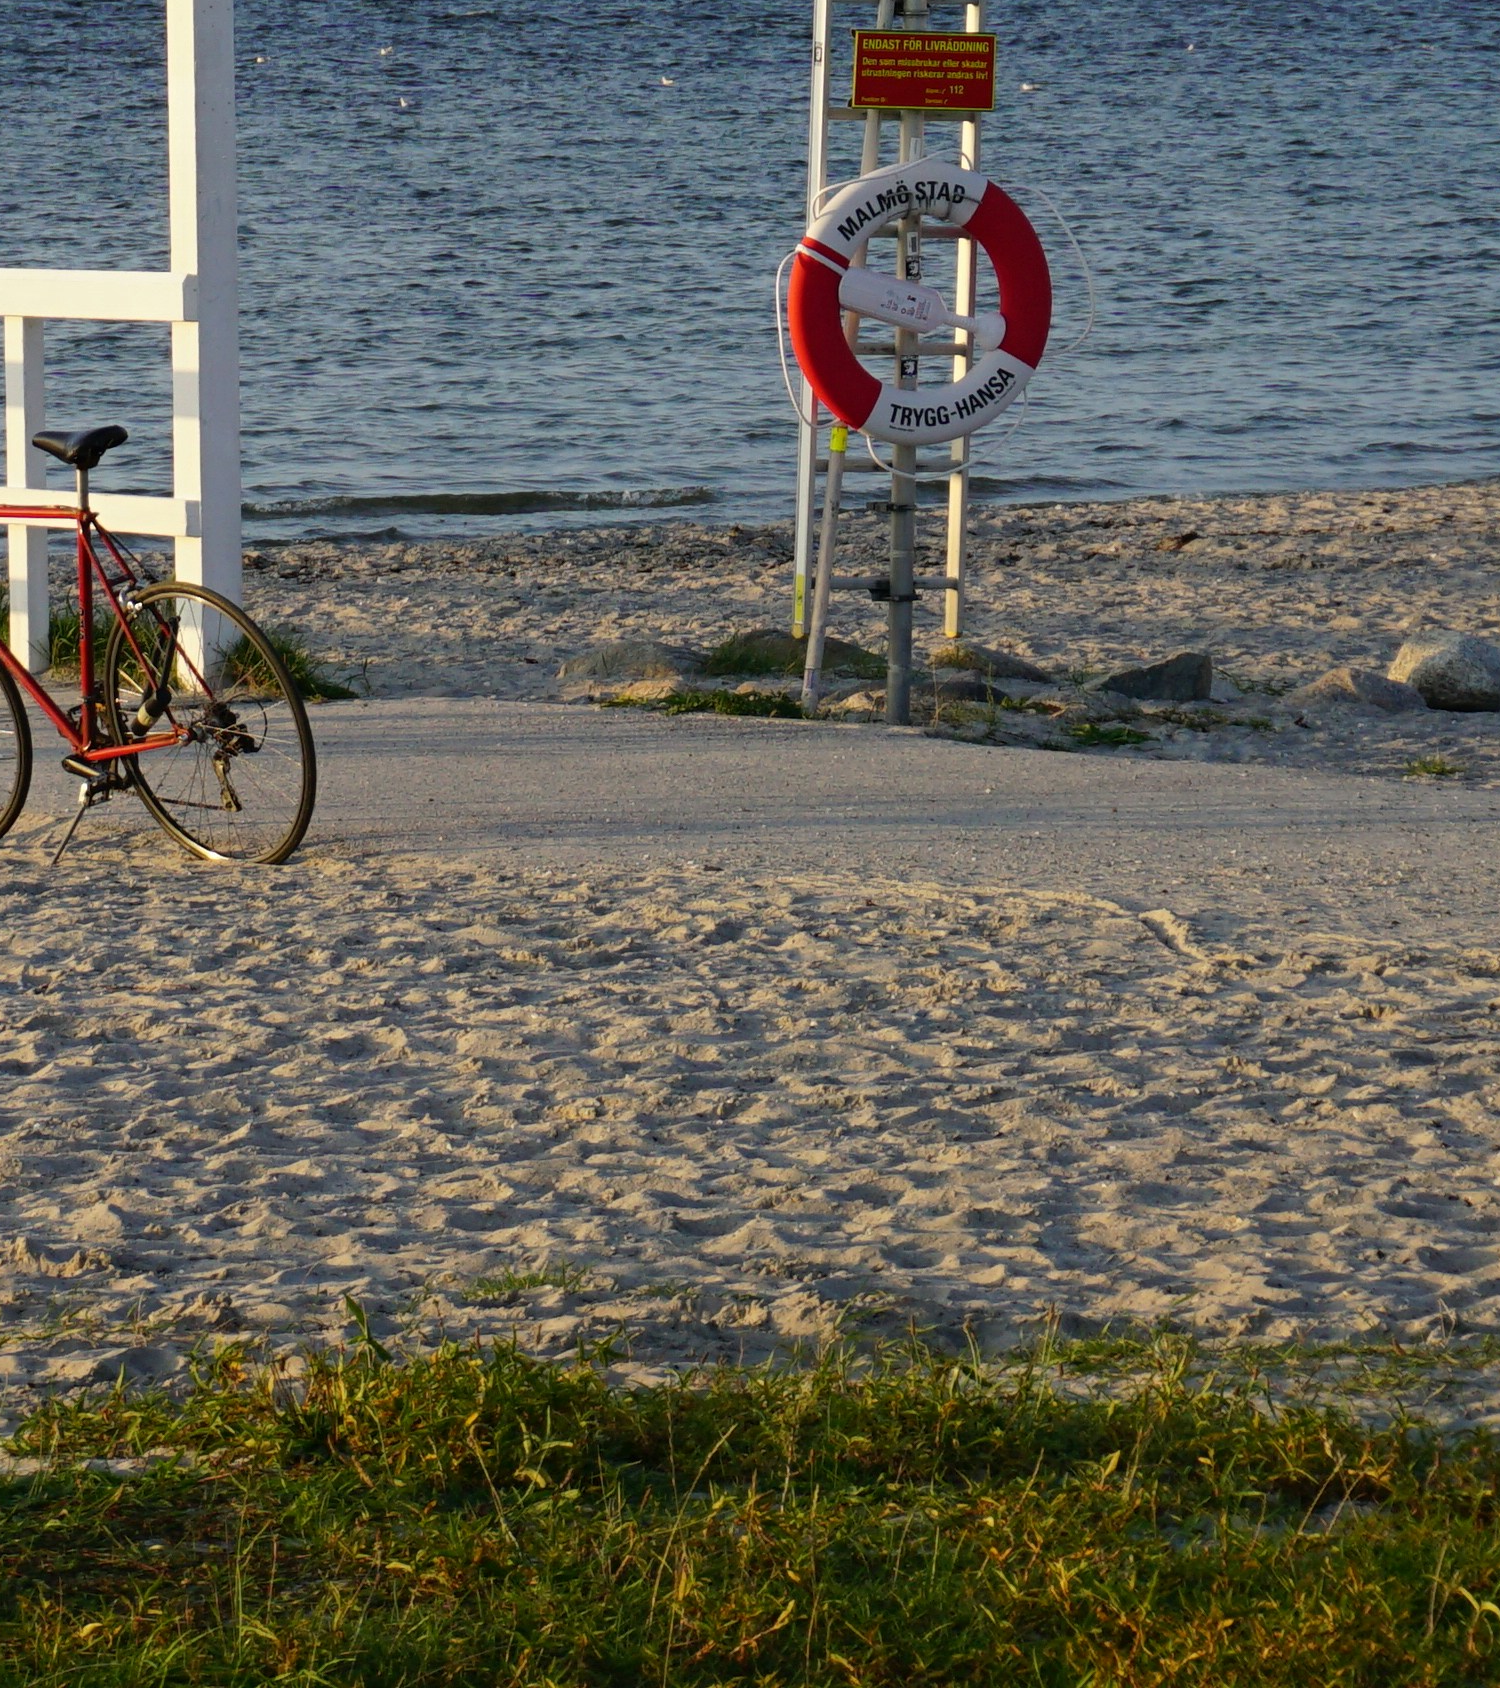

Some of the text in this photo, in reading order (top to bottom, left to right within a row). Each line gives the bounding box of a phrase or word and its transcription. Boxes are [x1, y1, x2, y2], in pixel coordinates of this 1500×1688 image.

[862, 37, 989, 52] ENDAST FÖR LIVRÄDDNING
[949, 85, 964, 95] 112
[837, 180, 966, 242] MALMÖ STAD
[890, 367, 1015, 428] TRYGG-HANSA
